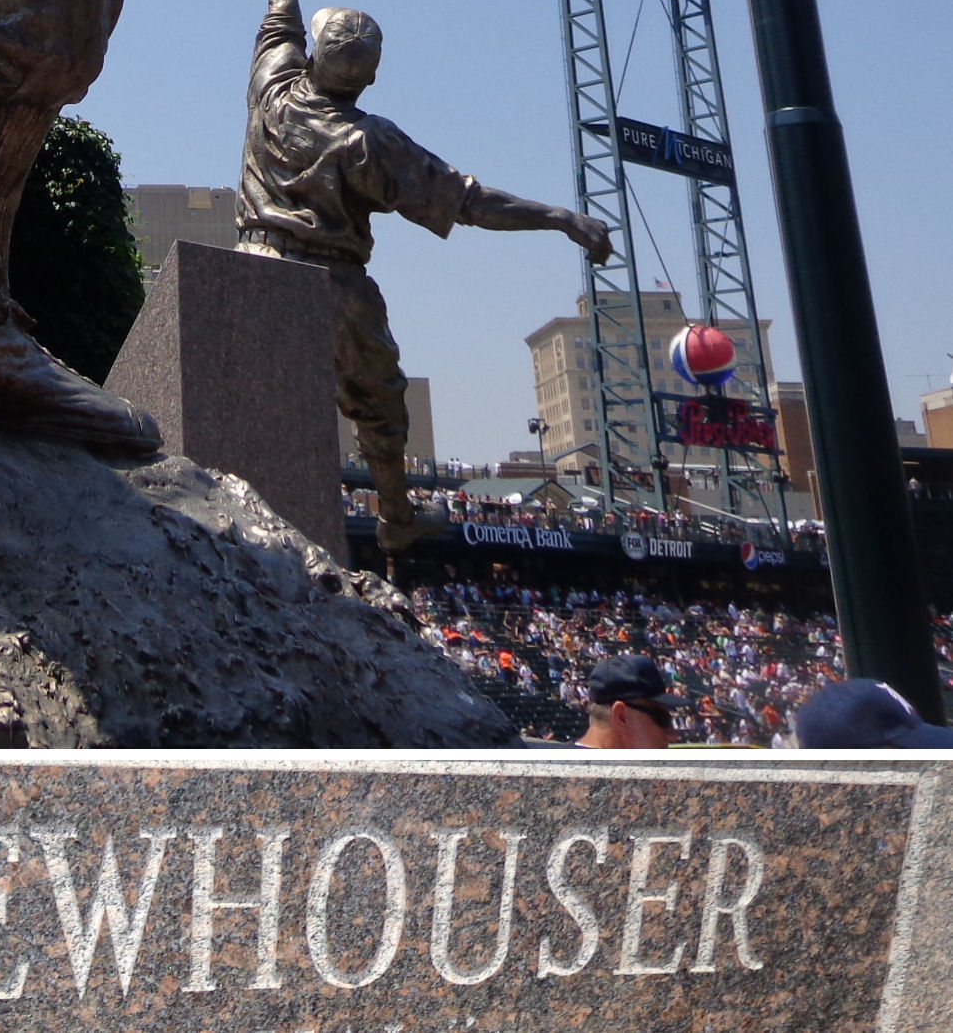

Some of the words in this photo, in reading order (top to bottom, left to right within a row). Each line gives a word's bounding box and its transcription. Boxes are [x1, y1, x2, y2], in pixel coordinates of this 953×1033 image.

[623, 126, 657, 150] PURE
[535, 527, 573, 550] Bank
[649, 537, 693, 559] DETROIT
[758, 550, 785, 565] pepsi
